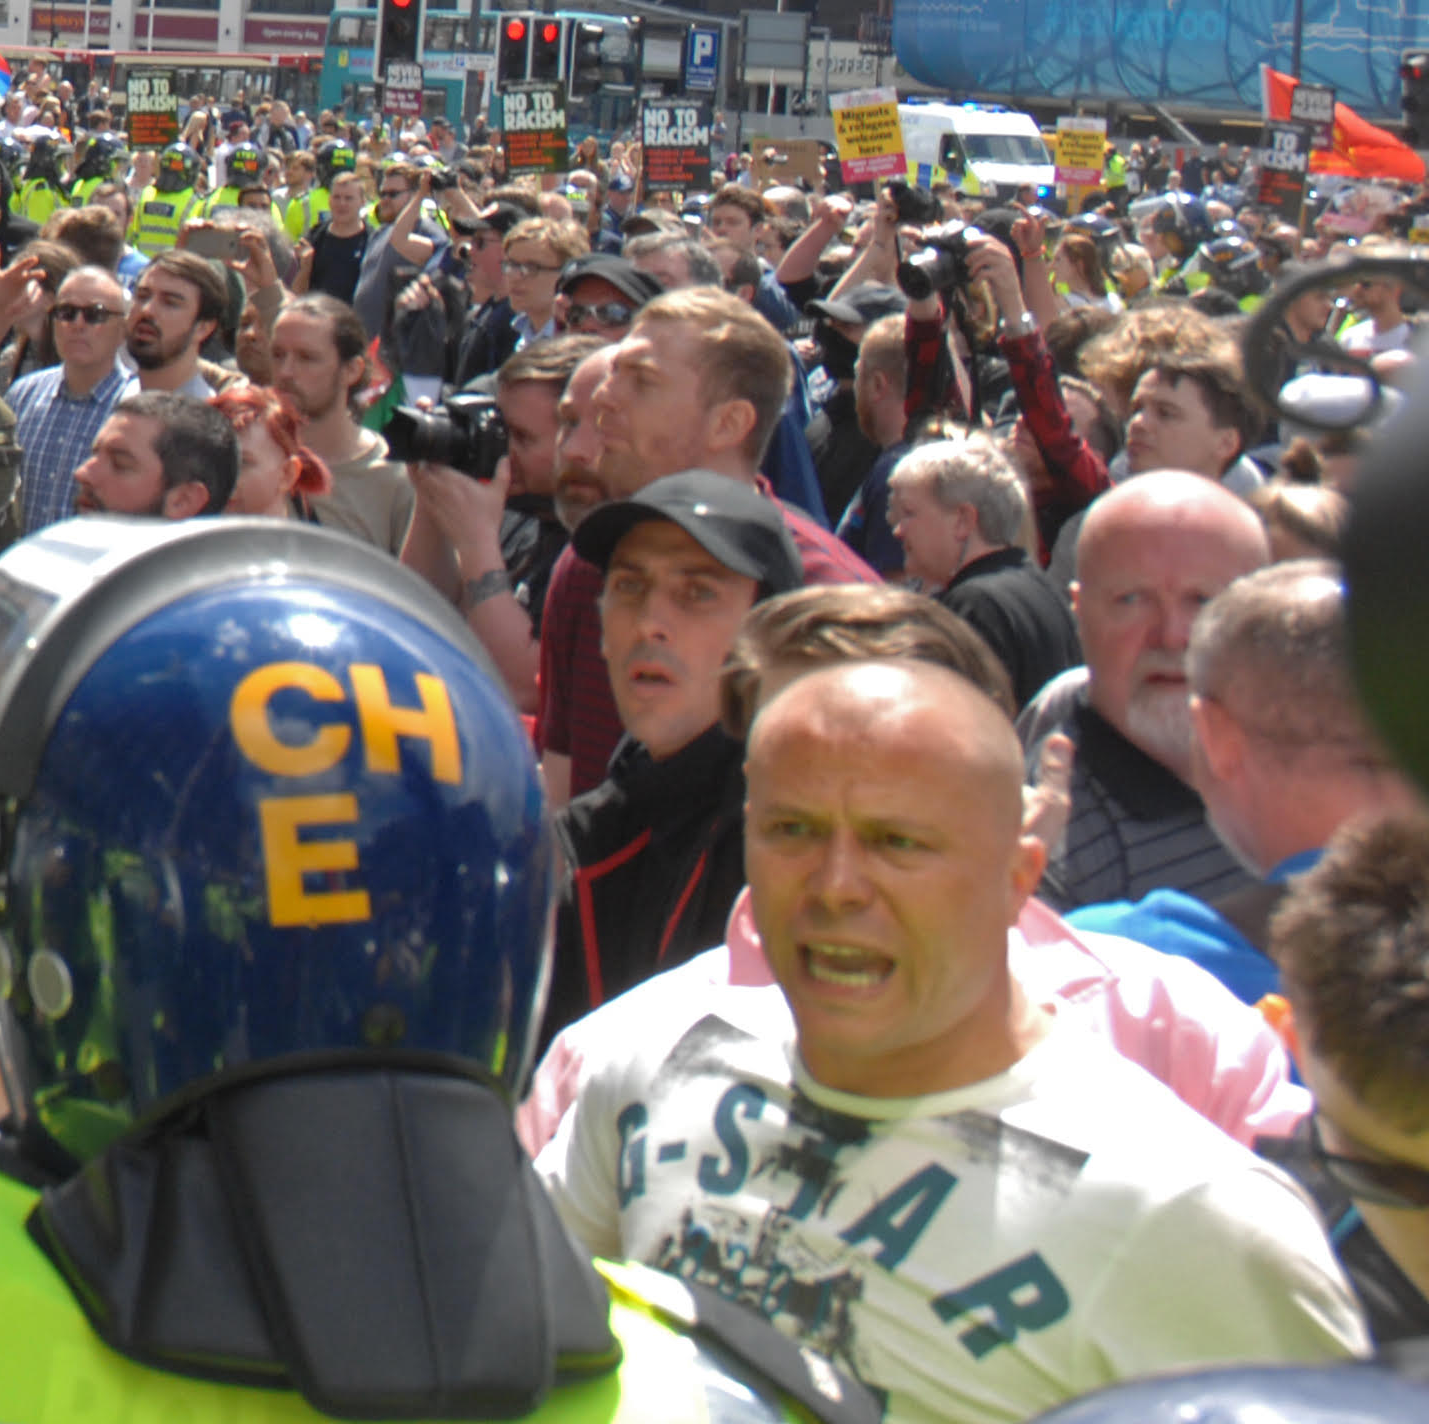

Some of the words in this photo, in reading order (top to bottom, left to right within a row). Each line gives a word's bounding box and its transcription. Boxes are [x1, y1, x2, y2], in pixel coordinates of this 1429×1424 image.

[694, 34, 712, 65] P
[128, 79, 150, 95] NO
[152, 78, 169, 95] TO
[128, 94, 177, 112] RACISM
[503, 92, 528, 112] NO
[532, 92, 554, 110] TO
[504, 109, 566, 130] RACISM
[644, 109, 669, 127] NO
[674, 109, 697, 126] TO
[841, 107, 890, 120] Migrants
[849, 119, 897, 133] refugees
[644, 127, 709, 146] RACISM
[846, 131, 894, 144] welcome
[1273, 131, 1299, 153] TO
[858, 144, 883, 154] here
[229, 661, 463, 787] CH
[258, 794, 373, 928] E
